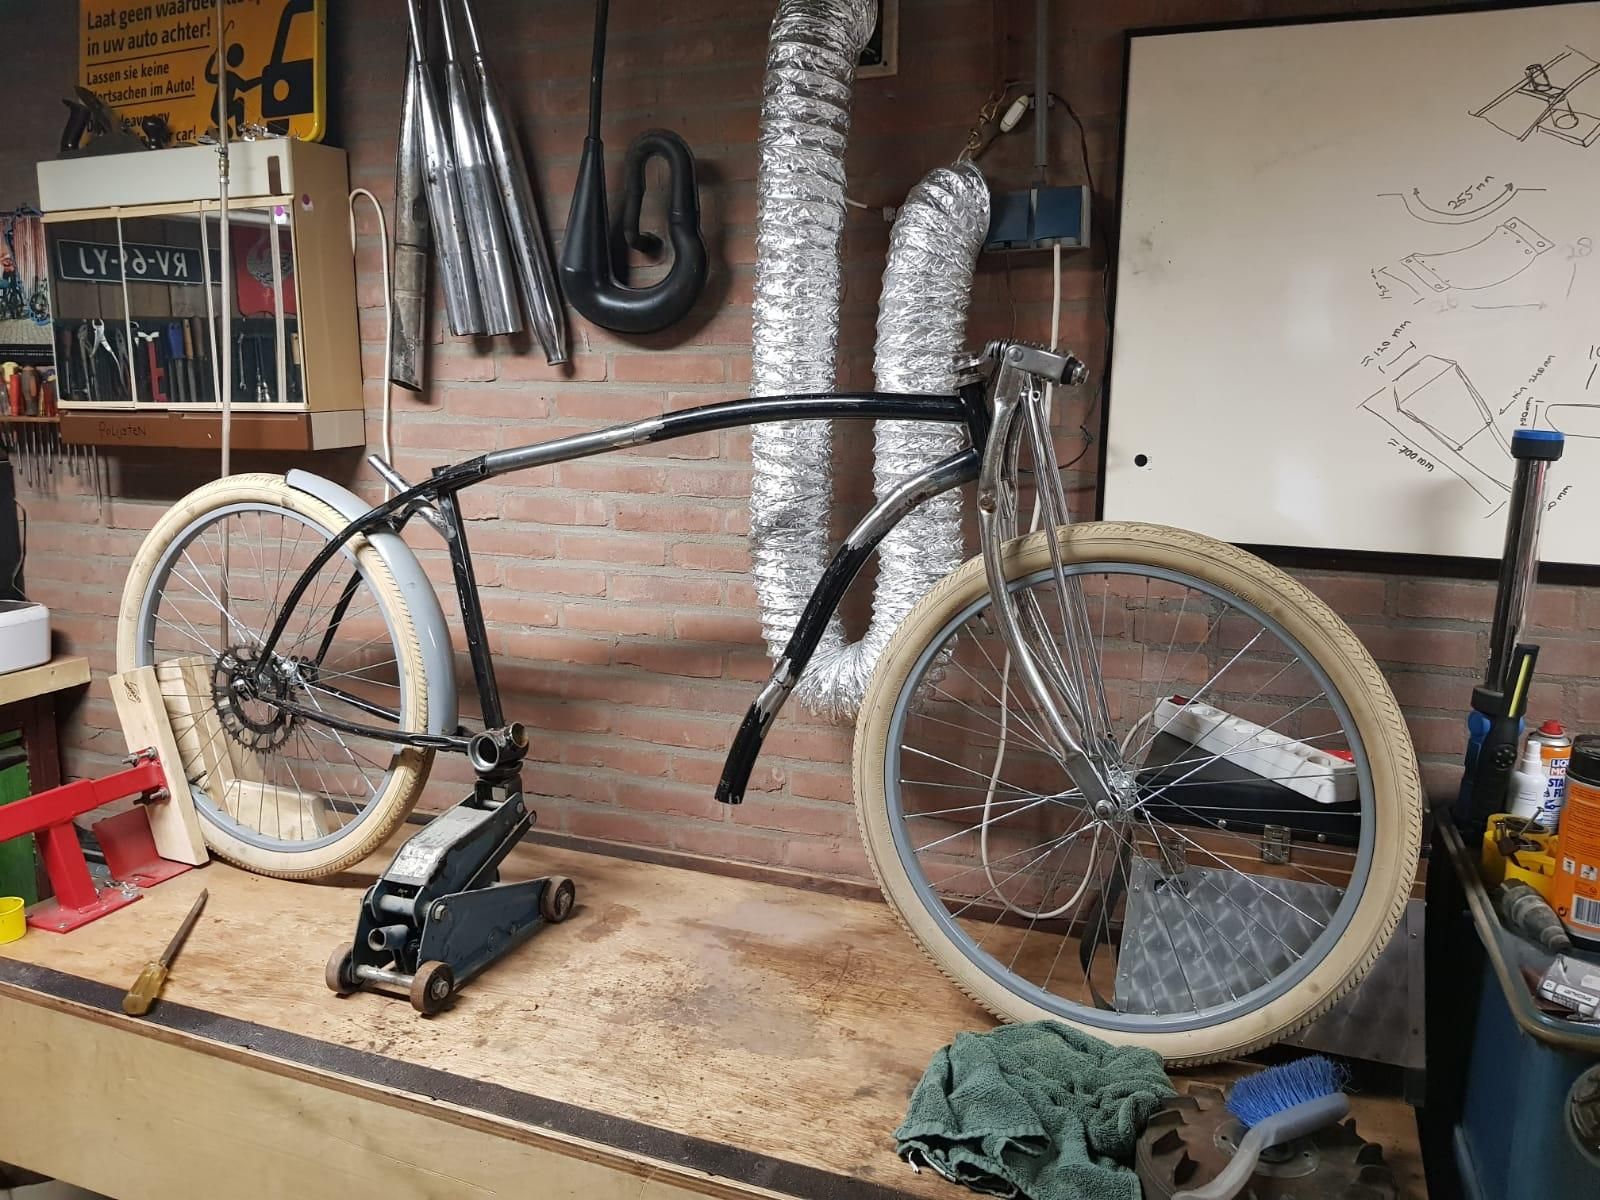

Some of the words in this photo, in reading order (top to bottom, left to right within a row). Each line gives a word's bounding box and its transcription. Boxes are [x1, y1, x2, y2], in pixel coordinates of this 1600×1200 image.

[87, 8, 116, 31] Laat
[119, 3, 152, 30] geen
[87, 38, 100, 57] in
[103, 37, 125, 55] uw
[127, 30, 158, 51] auto
[161, 16, 211, 43] achter!
[87, 71, 121, 86] Lassen
[123, 65, 138, 81] sie
[141, 61, 170, 78] keine
[150, 82, 163, 97] im
[166, 76, 195, 95] Auto!
[176, 126, 196, 142] car!
[1447, 185, 1473, 210] 255
[1391, 320, 1412, 338] mm
[1416, 457, 1435, 472] mm
[1557, 485, 1573, 501] mm
[1547, 778, 1564, 788] STA
